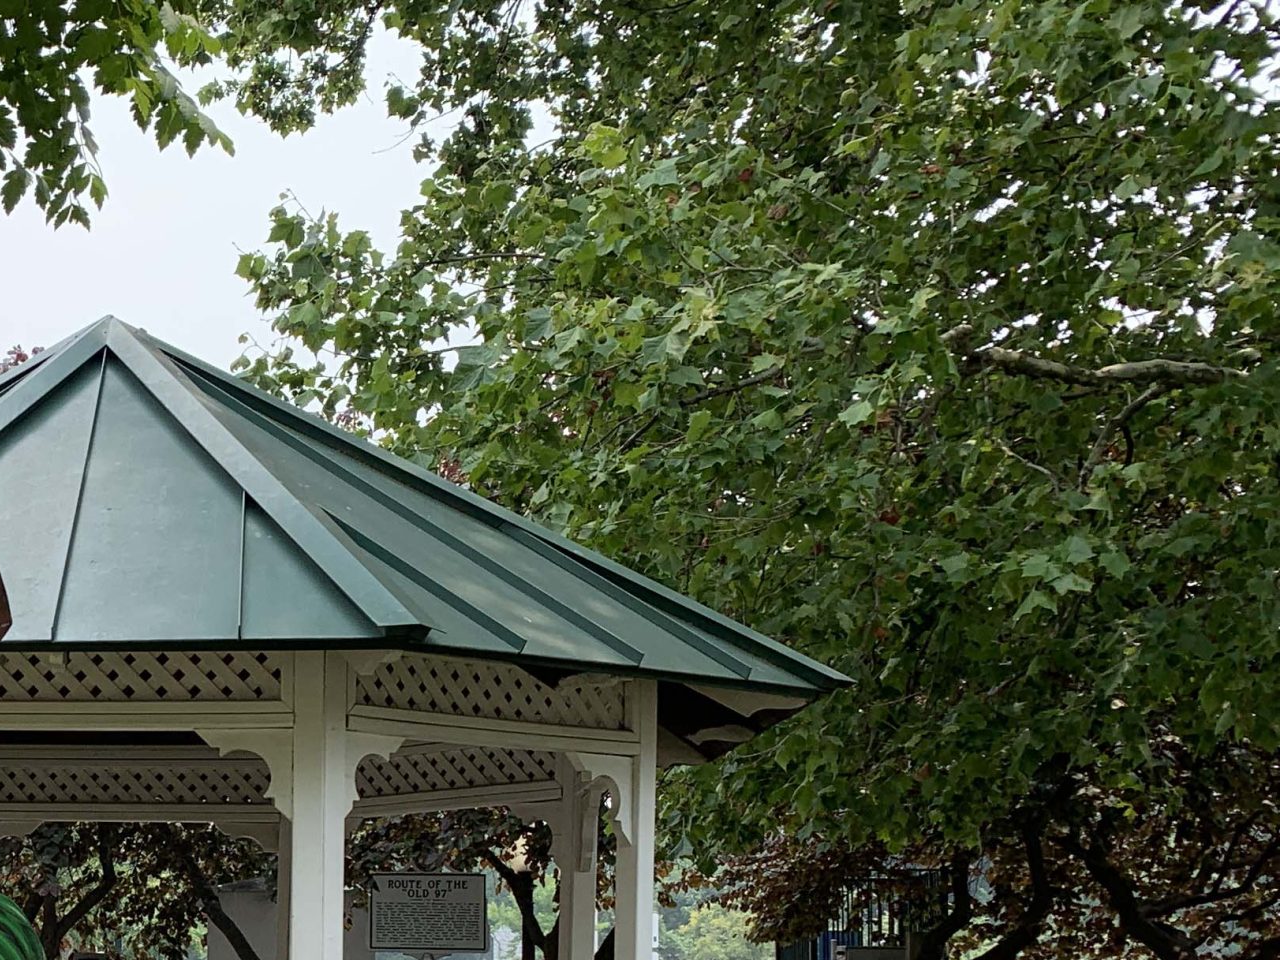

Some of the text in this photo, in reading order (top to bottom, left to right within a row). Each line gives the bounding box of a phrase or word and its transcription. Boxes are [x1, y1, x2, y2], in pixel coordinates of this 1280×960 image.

[387, 879, 468, 889] ROUTE OF THE
[402, 888, 452, 898] "OLD 97"
